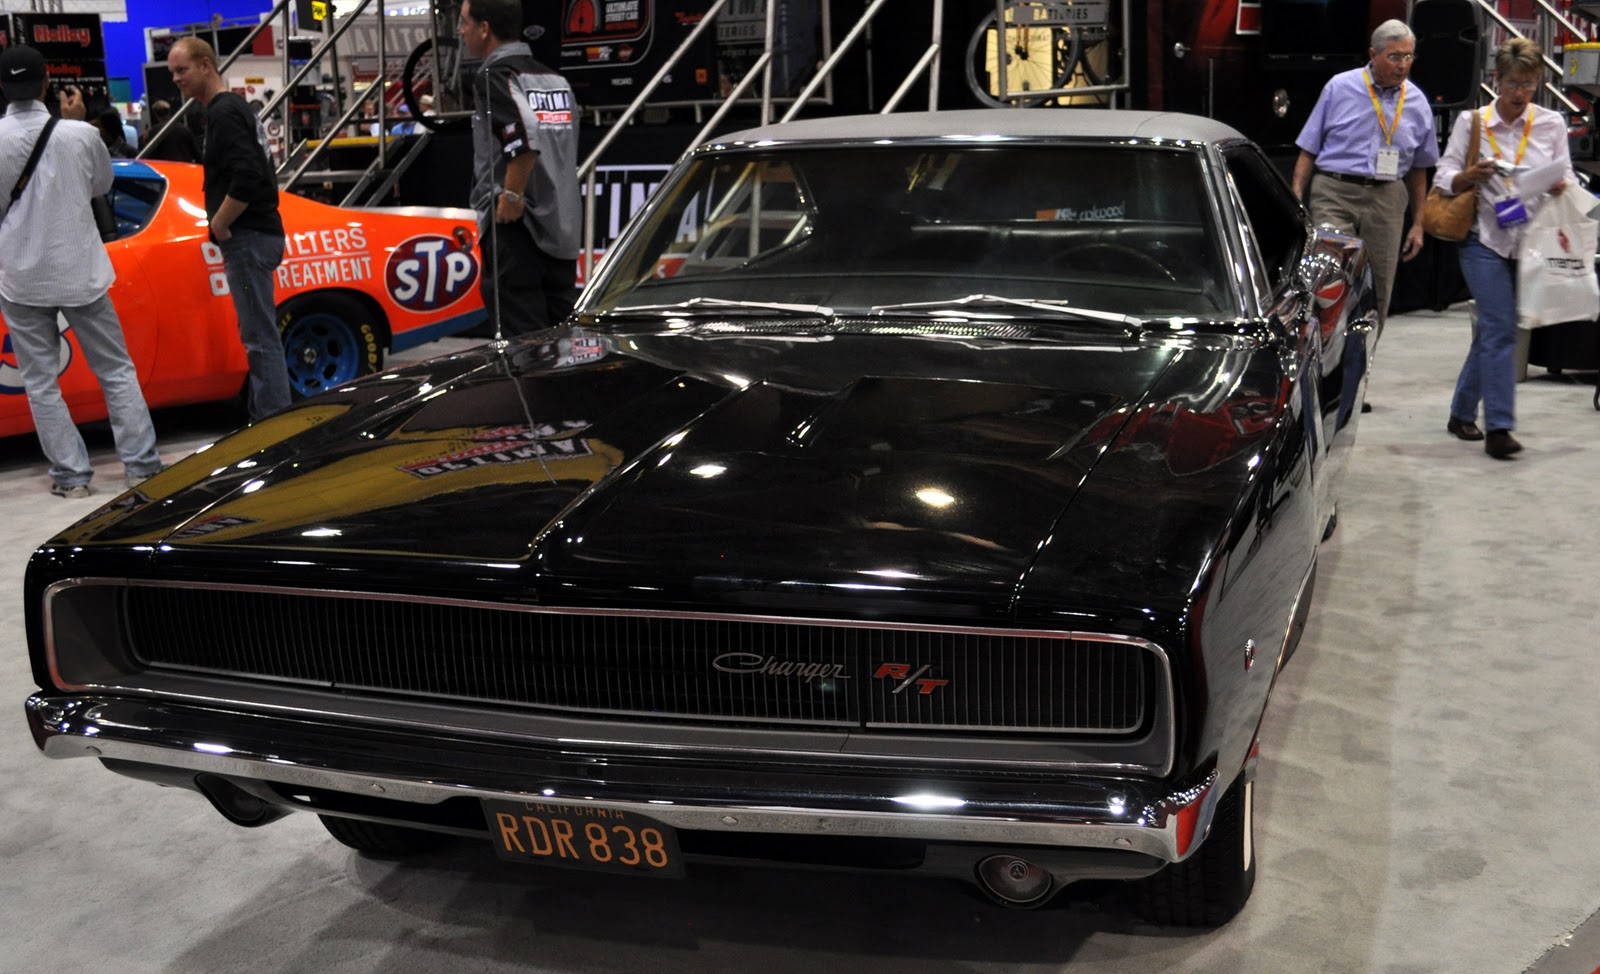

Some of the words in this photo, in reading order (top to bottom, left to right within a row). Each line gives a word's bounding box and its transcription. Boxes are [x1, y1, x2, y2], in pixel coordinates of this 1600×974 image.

[33, 24, 91, 47] Holley
[284, 227, 368, 257] ILTERS
[276, 256, 373, 290] REATMENT
[394, 239, 472, 305] STP
[712, 652, 852, 684] Charger
[873, 662, 949, 695] R/T
[524, 801, 625, 820] CALIFORNIA
[496, 812, 580, 860] RDR
[584, 822, 669, 868] 838
